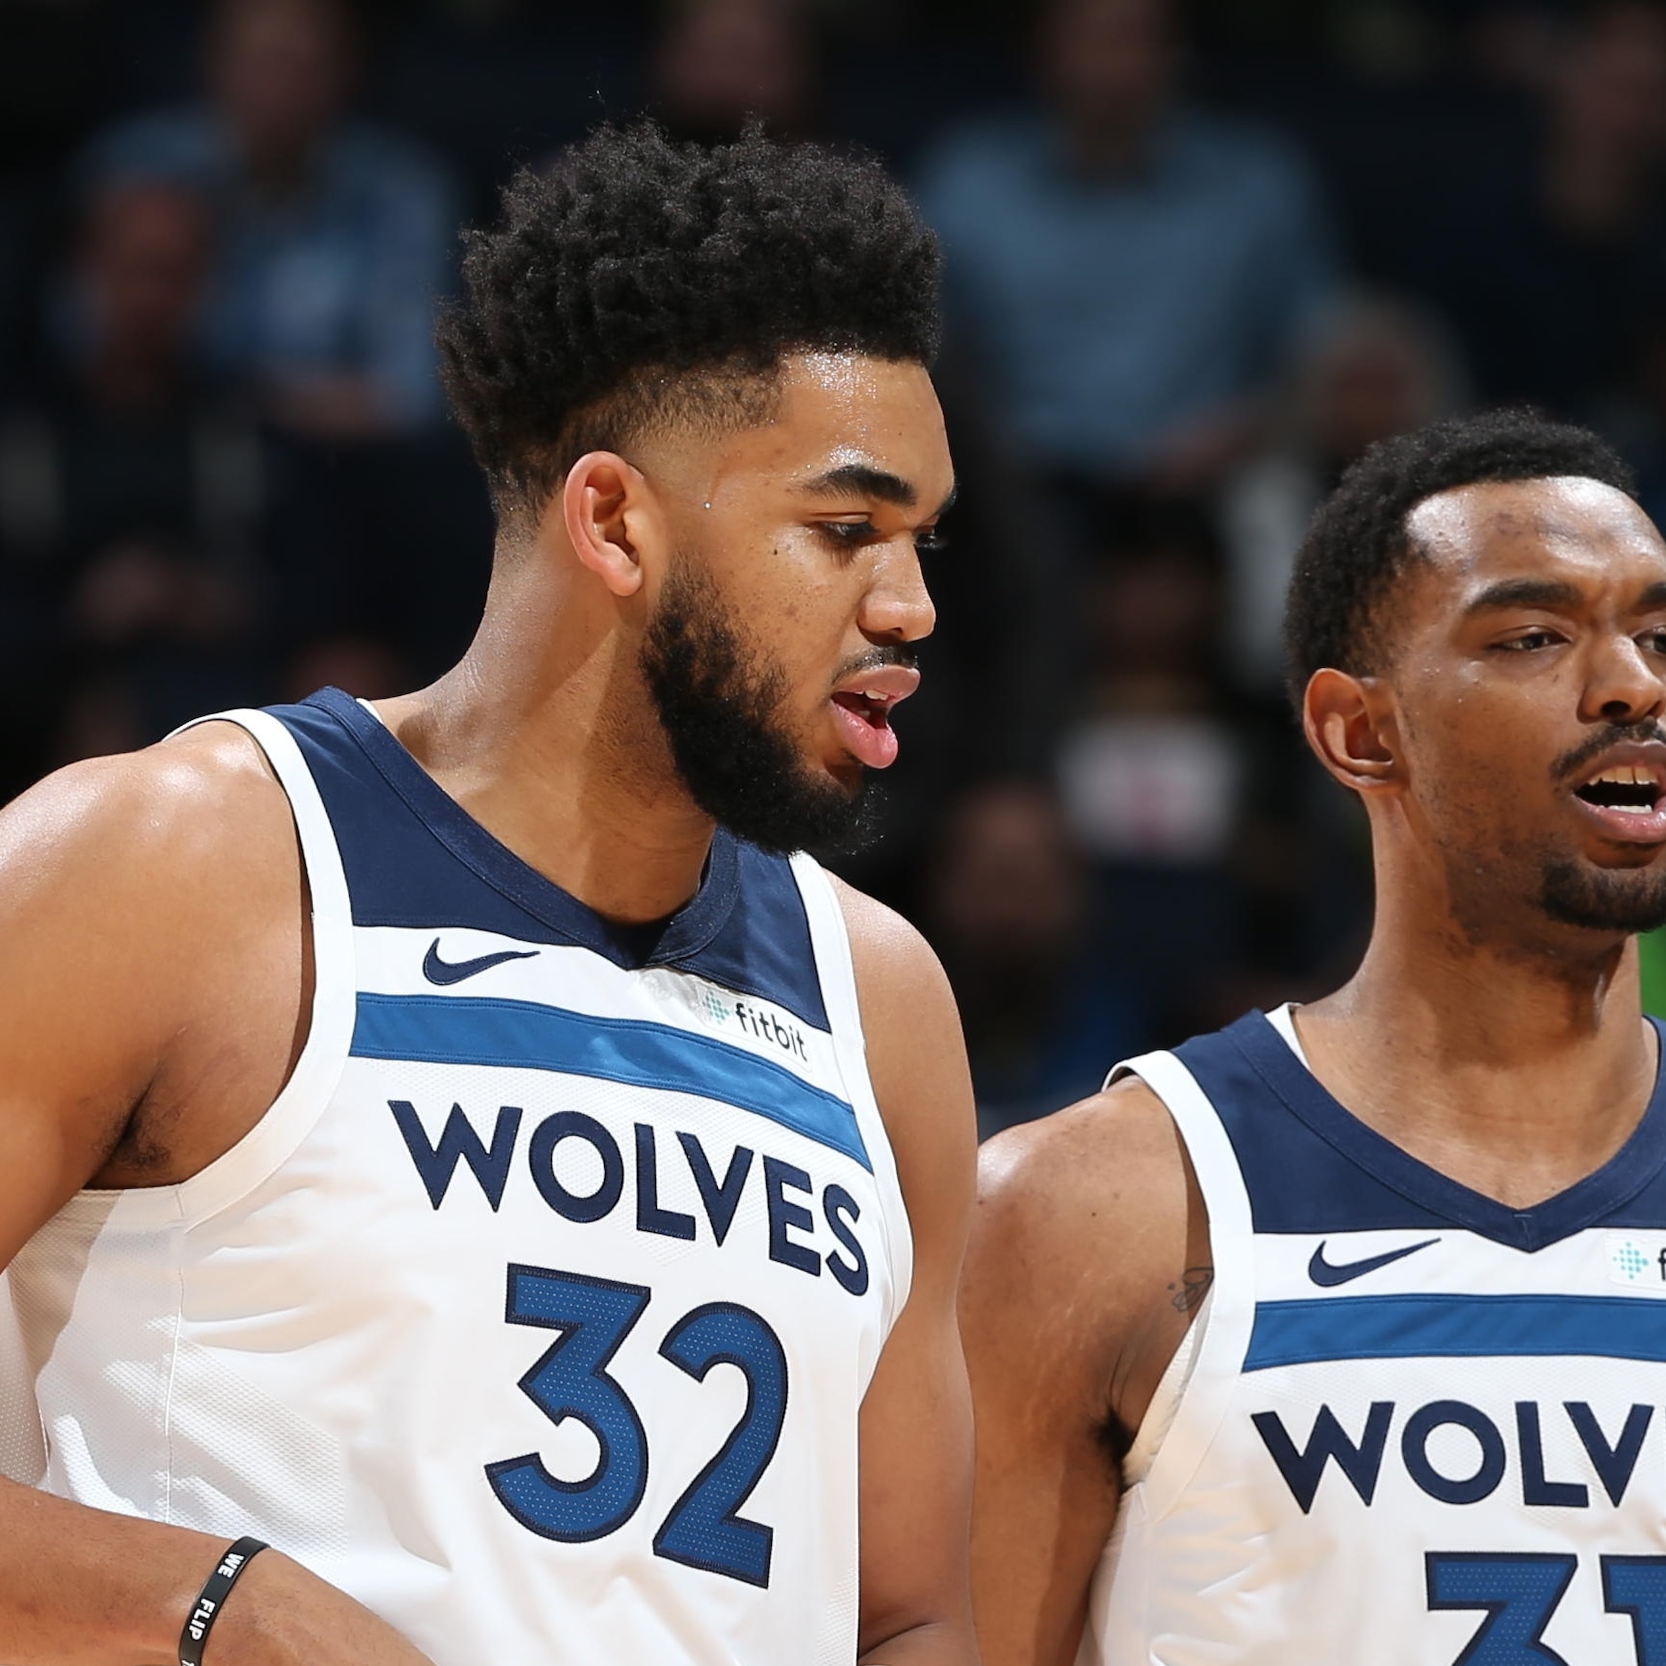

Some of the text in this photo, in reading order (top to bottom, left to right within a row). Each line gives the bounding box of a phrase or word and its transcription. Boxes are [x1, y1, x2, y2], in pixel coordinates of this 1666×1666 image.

[735, 1003, 808, 1062] fitbit
[387, 1099, 869, 1297] WOLVES
[484, 1262, 789, 1590] 32
[218, 1553, 244, 1578] WE
[189, 1598, 216, 1640] FLIP
